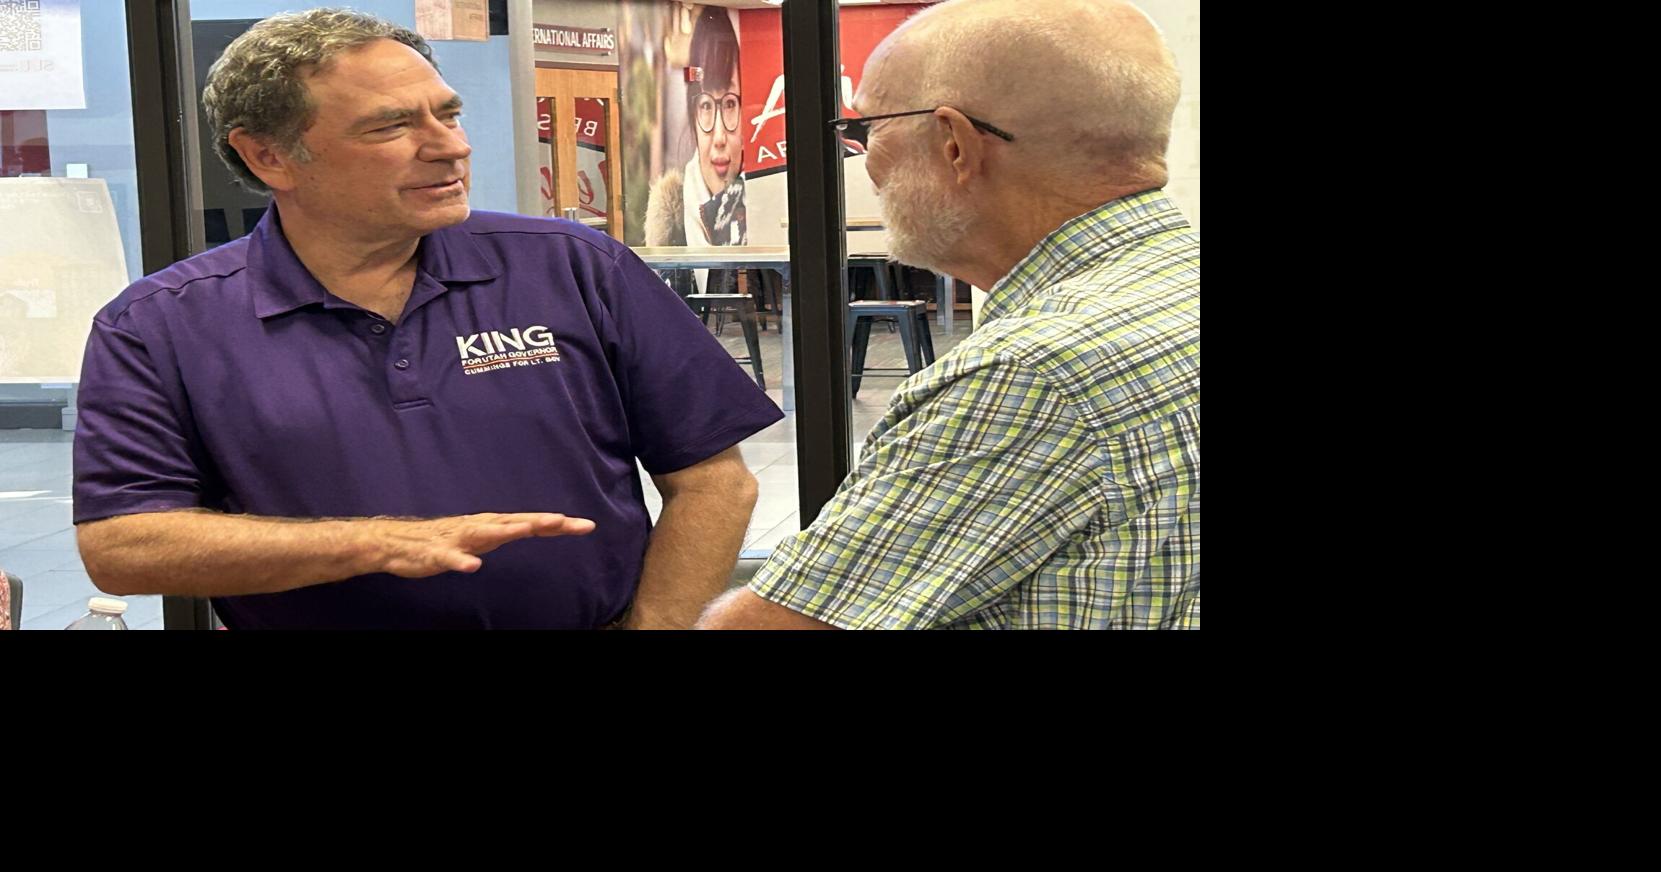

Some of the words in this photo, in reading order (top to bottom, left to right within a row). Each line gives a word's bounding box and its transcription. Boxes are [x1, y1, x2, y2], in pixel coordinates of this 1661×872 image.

[582, 32, 615, 49] AFFAIRS
[456, 325, 555, 359] KING
[461, 357, 481, 366] FOR
[481, 353, 507, 363] UTAH
[508, 346, 558, 358] GOVERNOR
[464, 362, 511, 375] CUMMINGS
